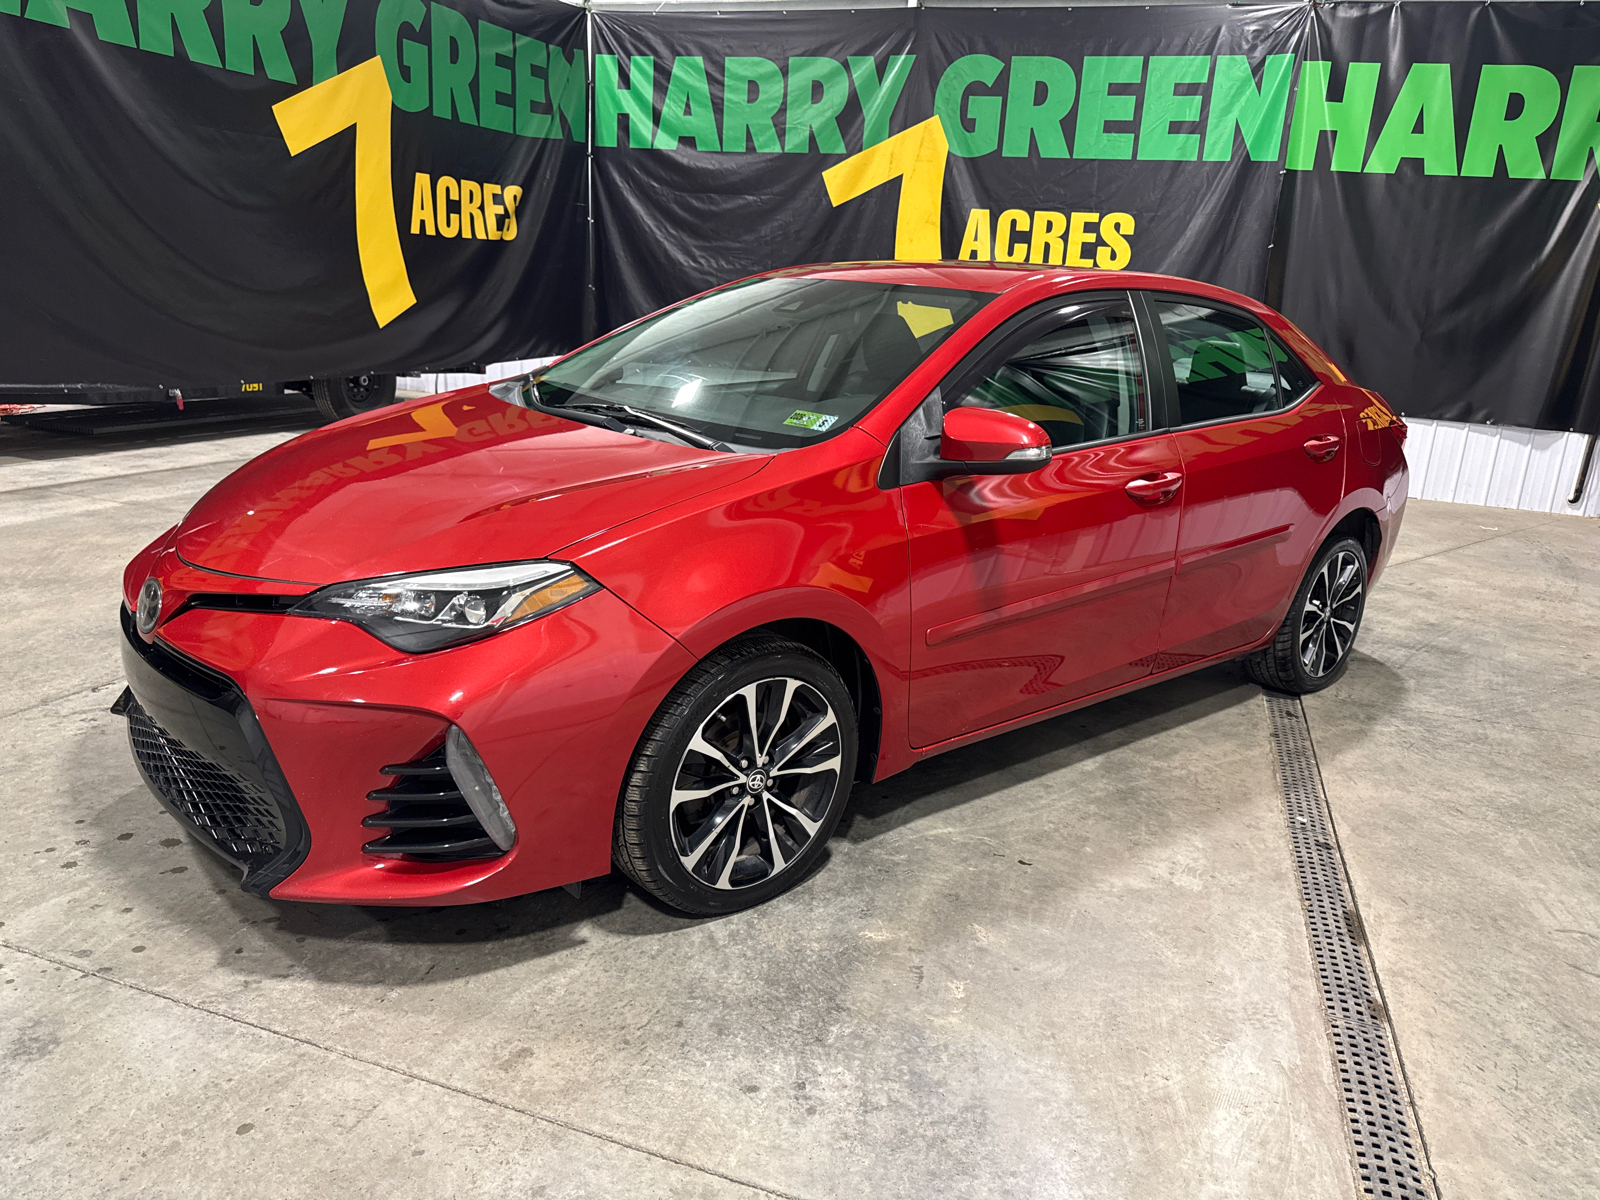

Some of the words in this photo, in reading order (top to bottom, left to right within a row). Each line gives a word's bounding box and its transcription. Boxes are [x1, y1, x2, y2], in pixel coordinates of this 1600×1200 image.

[375, 0, 586, 143] GREEN
[594, 54, 916, 154] HARRY
[934, 53, 1295, 161] GREEN
[272, 55, 417, 328] 7
[410, 172, 523, 241] ACRES
[822, 115, 949, 261] 7
[958, 208, 1135, 271] ACRES
